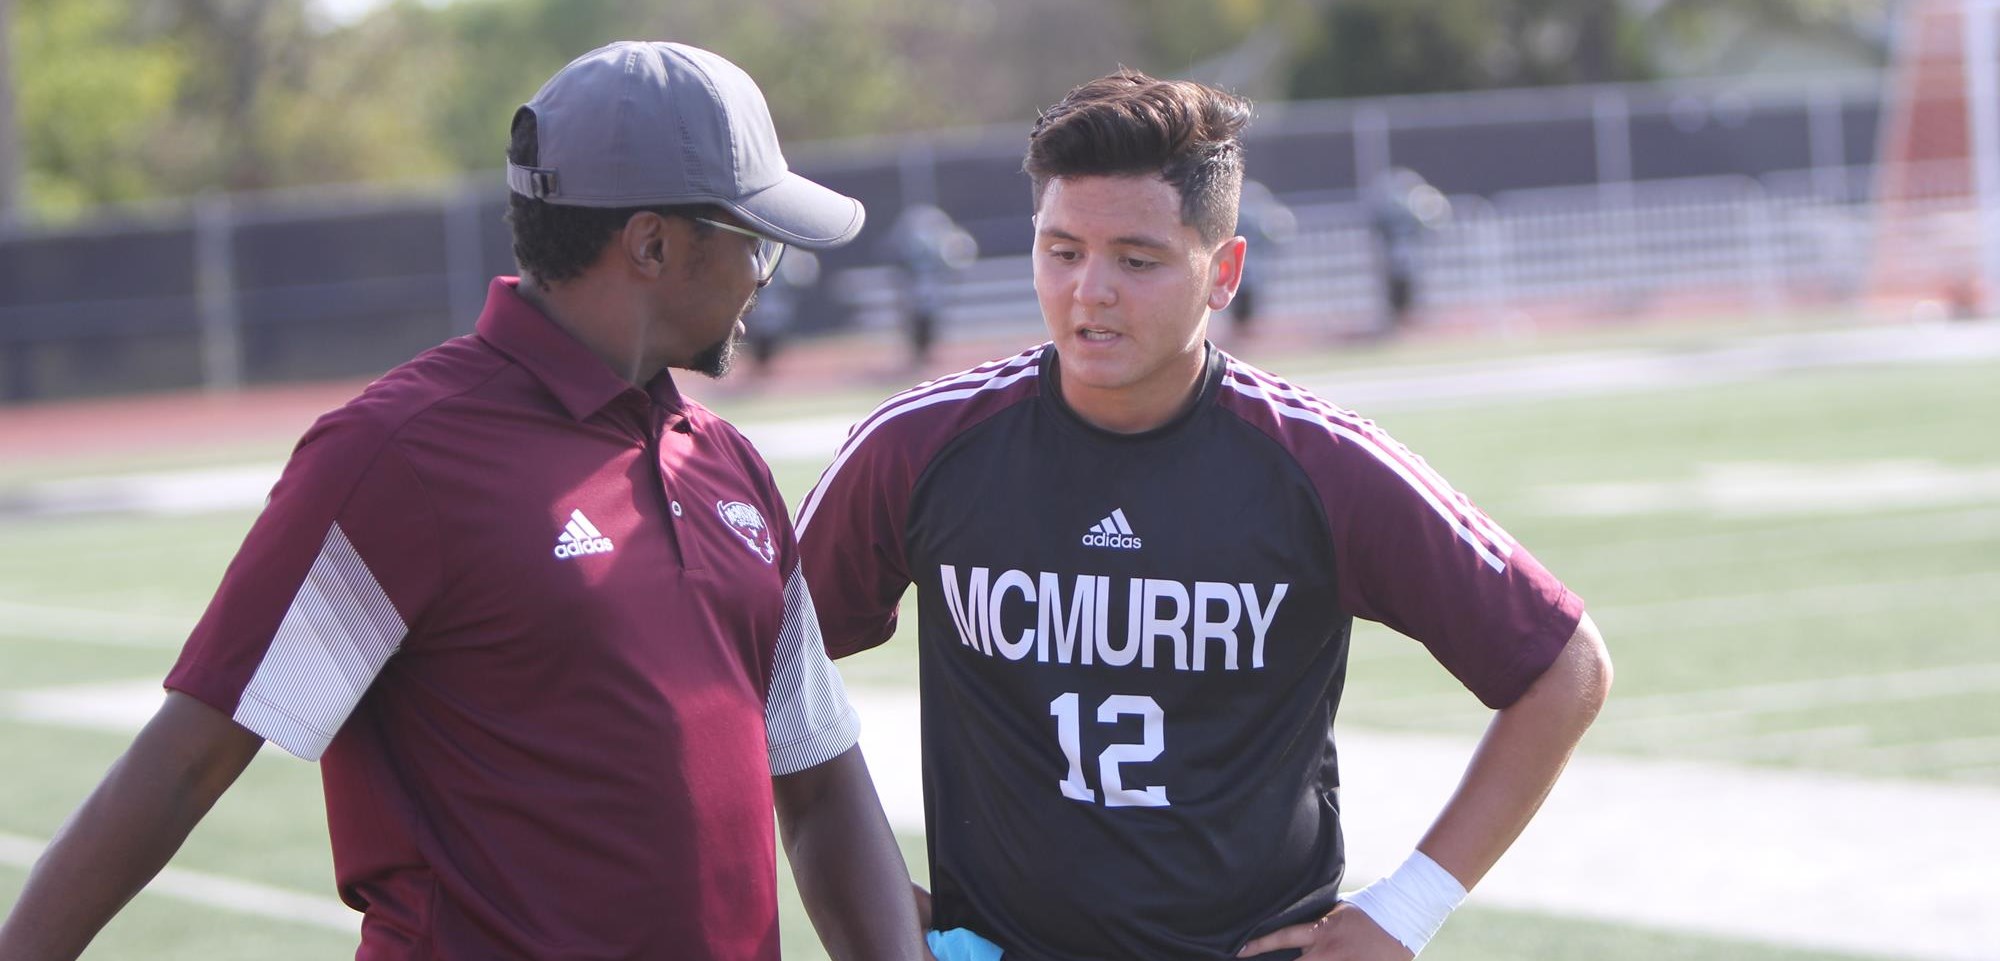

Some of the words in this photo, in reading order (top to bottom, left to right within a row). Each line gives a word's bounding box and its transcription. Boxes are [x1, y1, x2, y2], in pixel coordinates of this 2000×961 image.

[554, 536, 614, 558] adidas
[1082, 532, 1142, 549] adidas
[940, 564, 1289, 671] MCMURRY
[1050, 692, 1171, 808] 12
